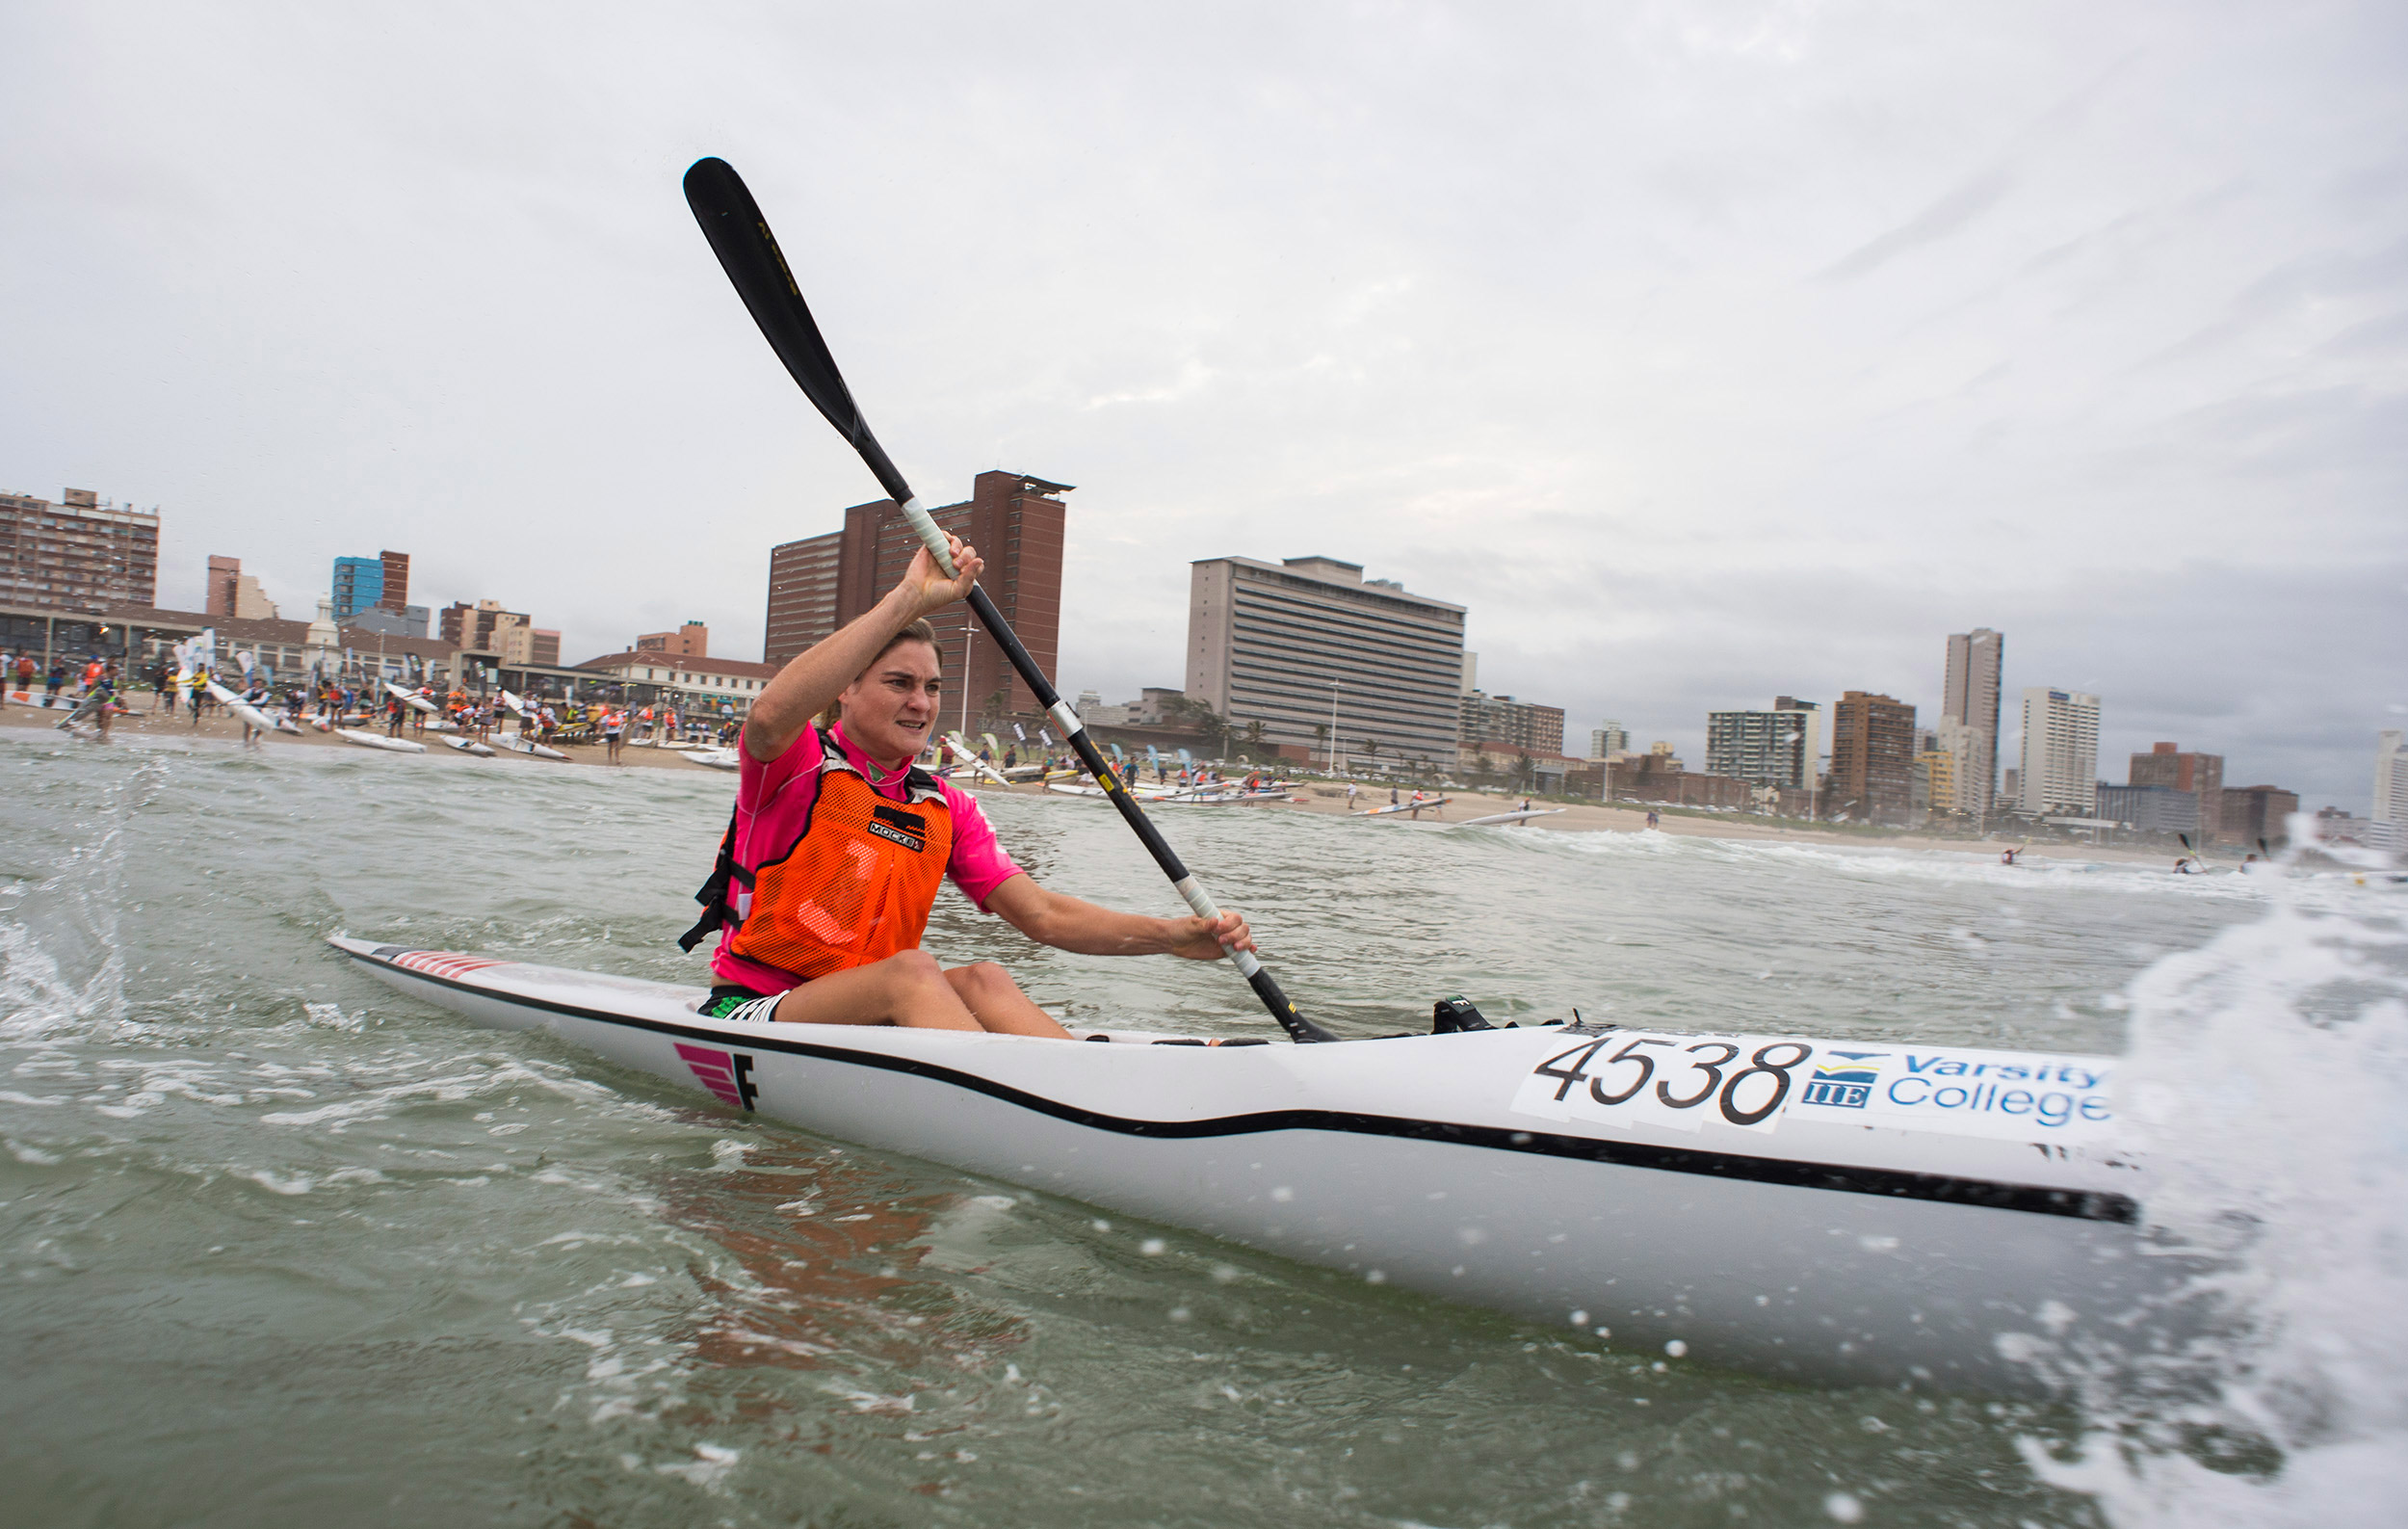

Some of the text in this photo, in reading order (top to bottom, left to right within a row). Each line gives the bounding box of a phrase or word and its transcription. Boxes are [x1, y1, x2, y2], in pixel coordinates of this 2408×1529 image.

[1533, 1037, 1813, 1125] 4538
[1905, 1054, 2109, 1090] Varsity
[1804, 1082, 1868, 1107] IIE
[1887, 1076, 2112, 1127] College
